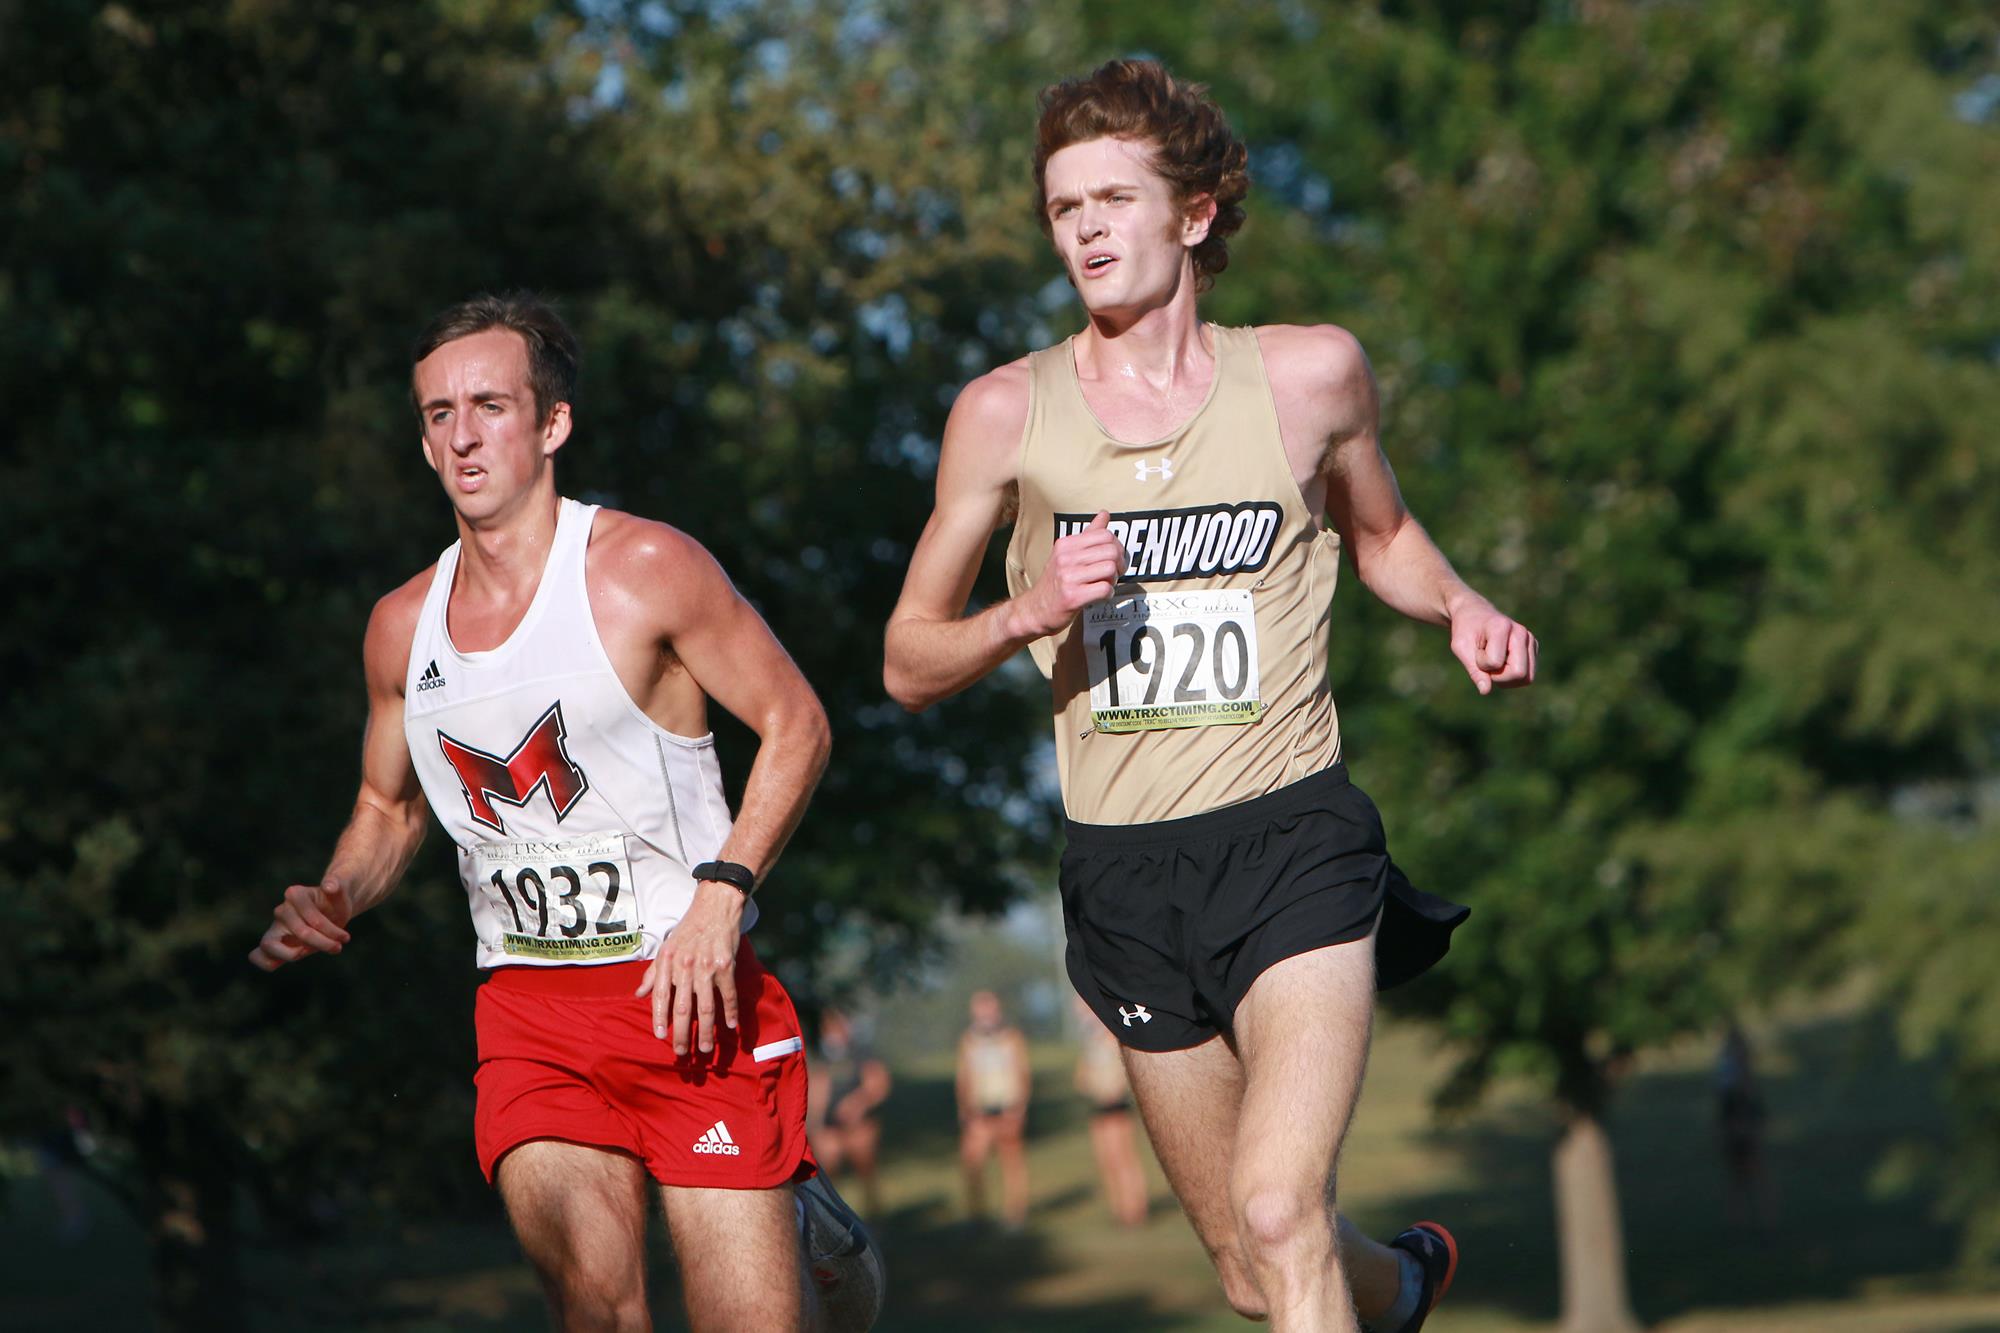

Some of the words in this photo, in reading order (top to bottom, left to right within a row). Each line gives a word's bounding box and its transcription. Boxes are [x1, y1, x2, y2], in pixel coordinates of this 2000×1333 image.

[1059, 509, 1278, 578] ENWOOD
[1100, 620, 1249, 707] 1920
[416, 677, 446, 692] adidas
[1096, 702, 1252, 721] WWW.TRXCTIMING.COM
[436, 698, 590, 836] M
[510, 841, 571, 855] TRXC
[490, 861, 627, 939] 1932
[506, 933, 634, 950] WWW.TRXCTIMING.COM
[692, 1140, 740, 1156] adidas
